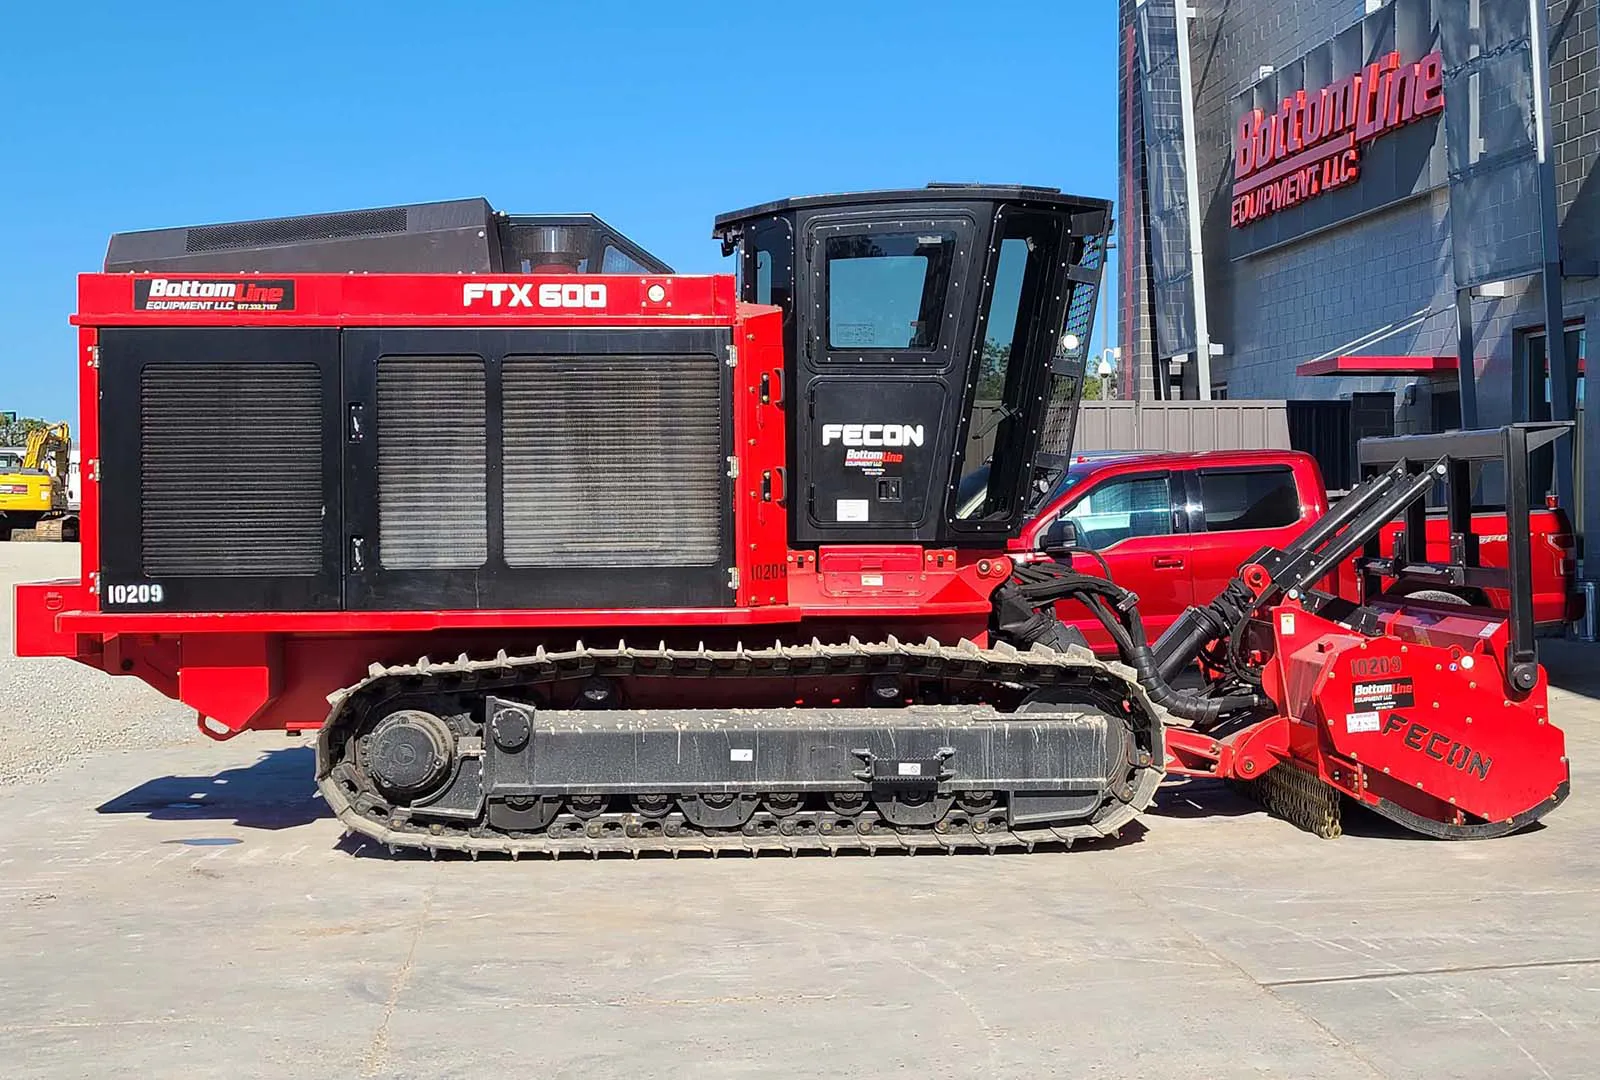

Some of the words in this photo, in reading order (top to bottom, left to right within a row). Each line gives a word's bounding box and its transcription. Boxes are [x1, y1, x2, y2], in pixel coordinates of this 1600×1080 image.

[1231, 165, 1321, 229] EQUIPMENT
[1321, 149, 1361, 191] LLC
[146, 301, 213, 310] EQUIPMENT
[214, 301, 234, 310] LLC
[463, 283, 533, 307] FTX
[538, 284, 607, 308] 600
[822, 424, 924, 447] FECON
[751, 563, 787, 581] 10209
[108, 584, 163, 604] 10209
[1351, 656, 1402, 676] 10209
[1382, 713, 1493, 781] FECON
